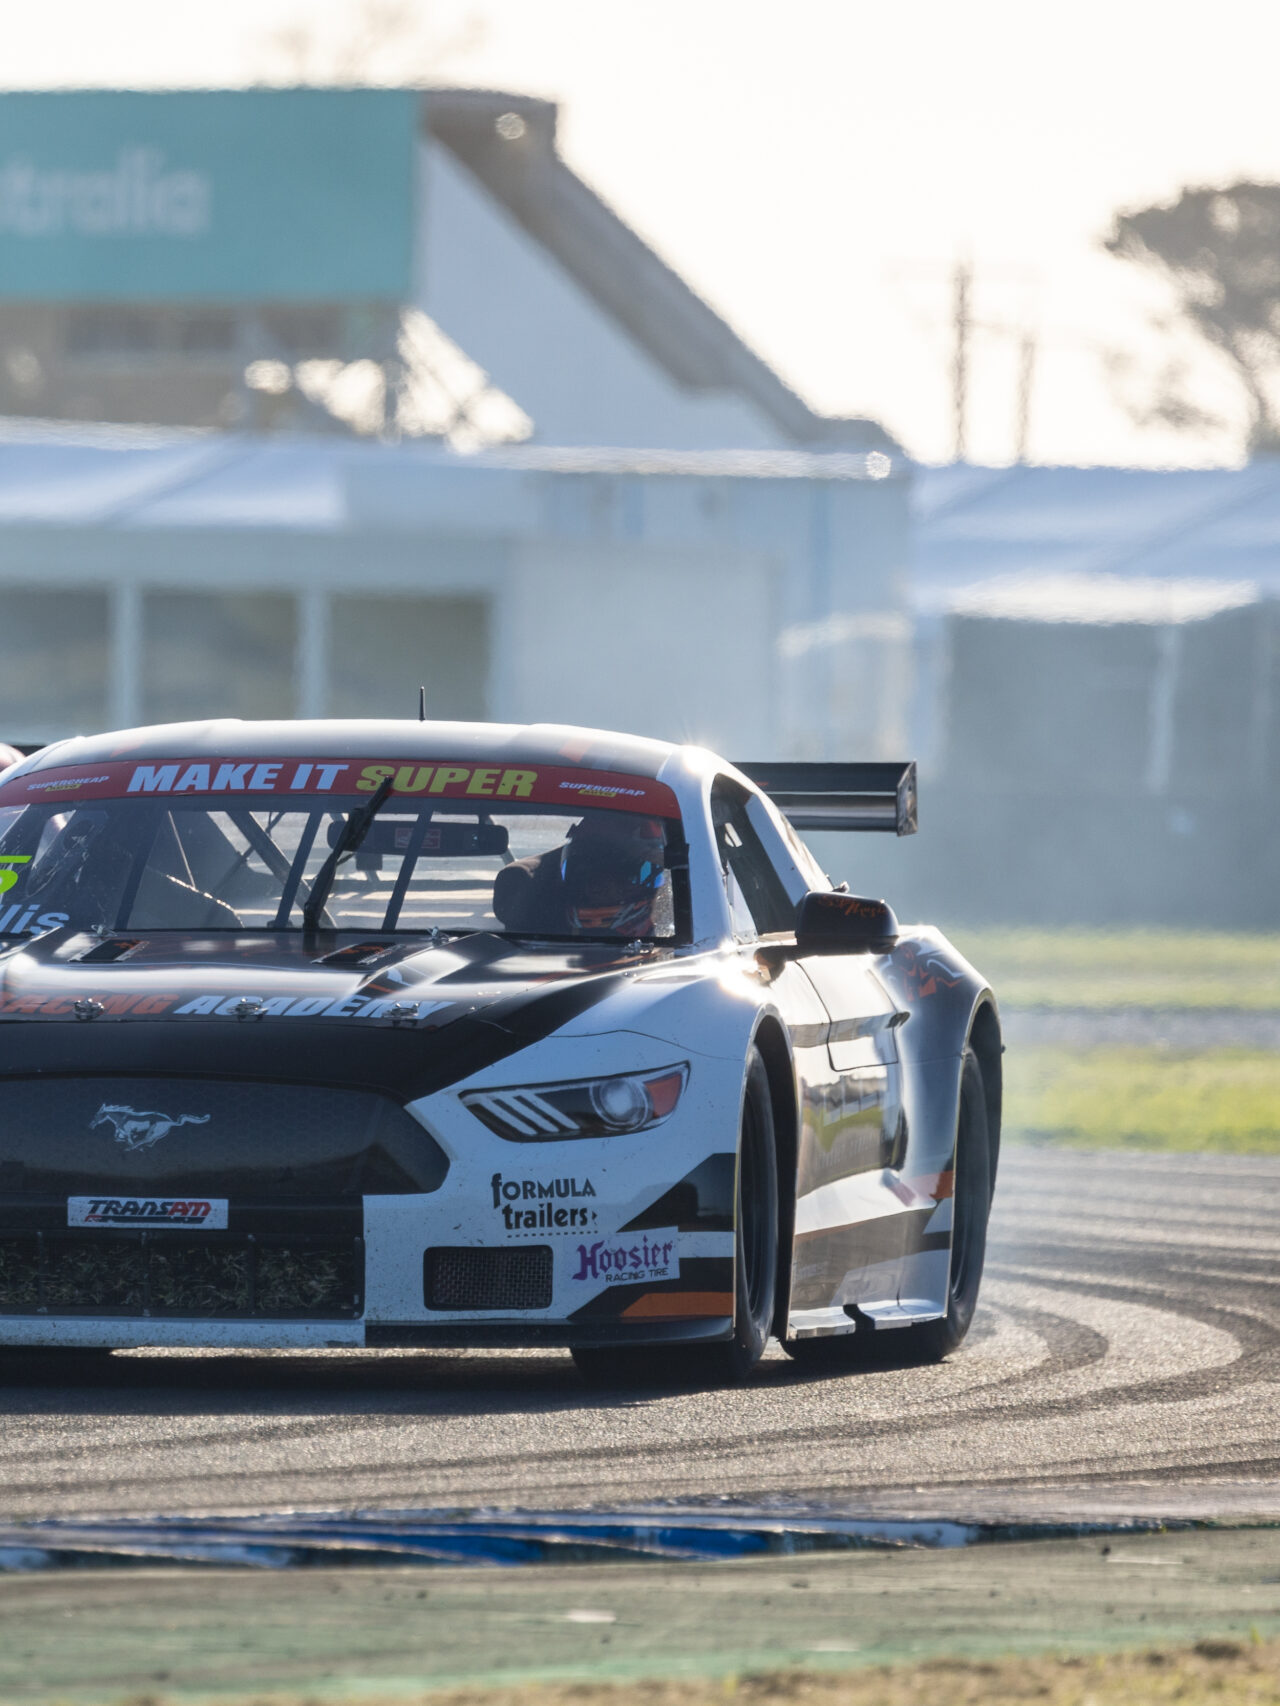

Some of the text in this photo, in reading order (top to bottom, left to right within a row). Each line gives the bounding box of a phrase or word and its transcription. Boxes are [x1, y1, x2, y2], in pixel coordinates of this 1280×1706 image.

[126, 763, 539, 797] MAKE IT SUPER
[501, 1202, 589, 1230] trailers
[571, 1235, 674, 1282] Hoosier
[604, 1266, 670, 1284] RACING TIRE
